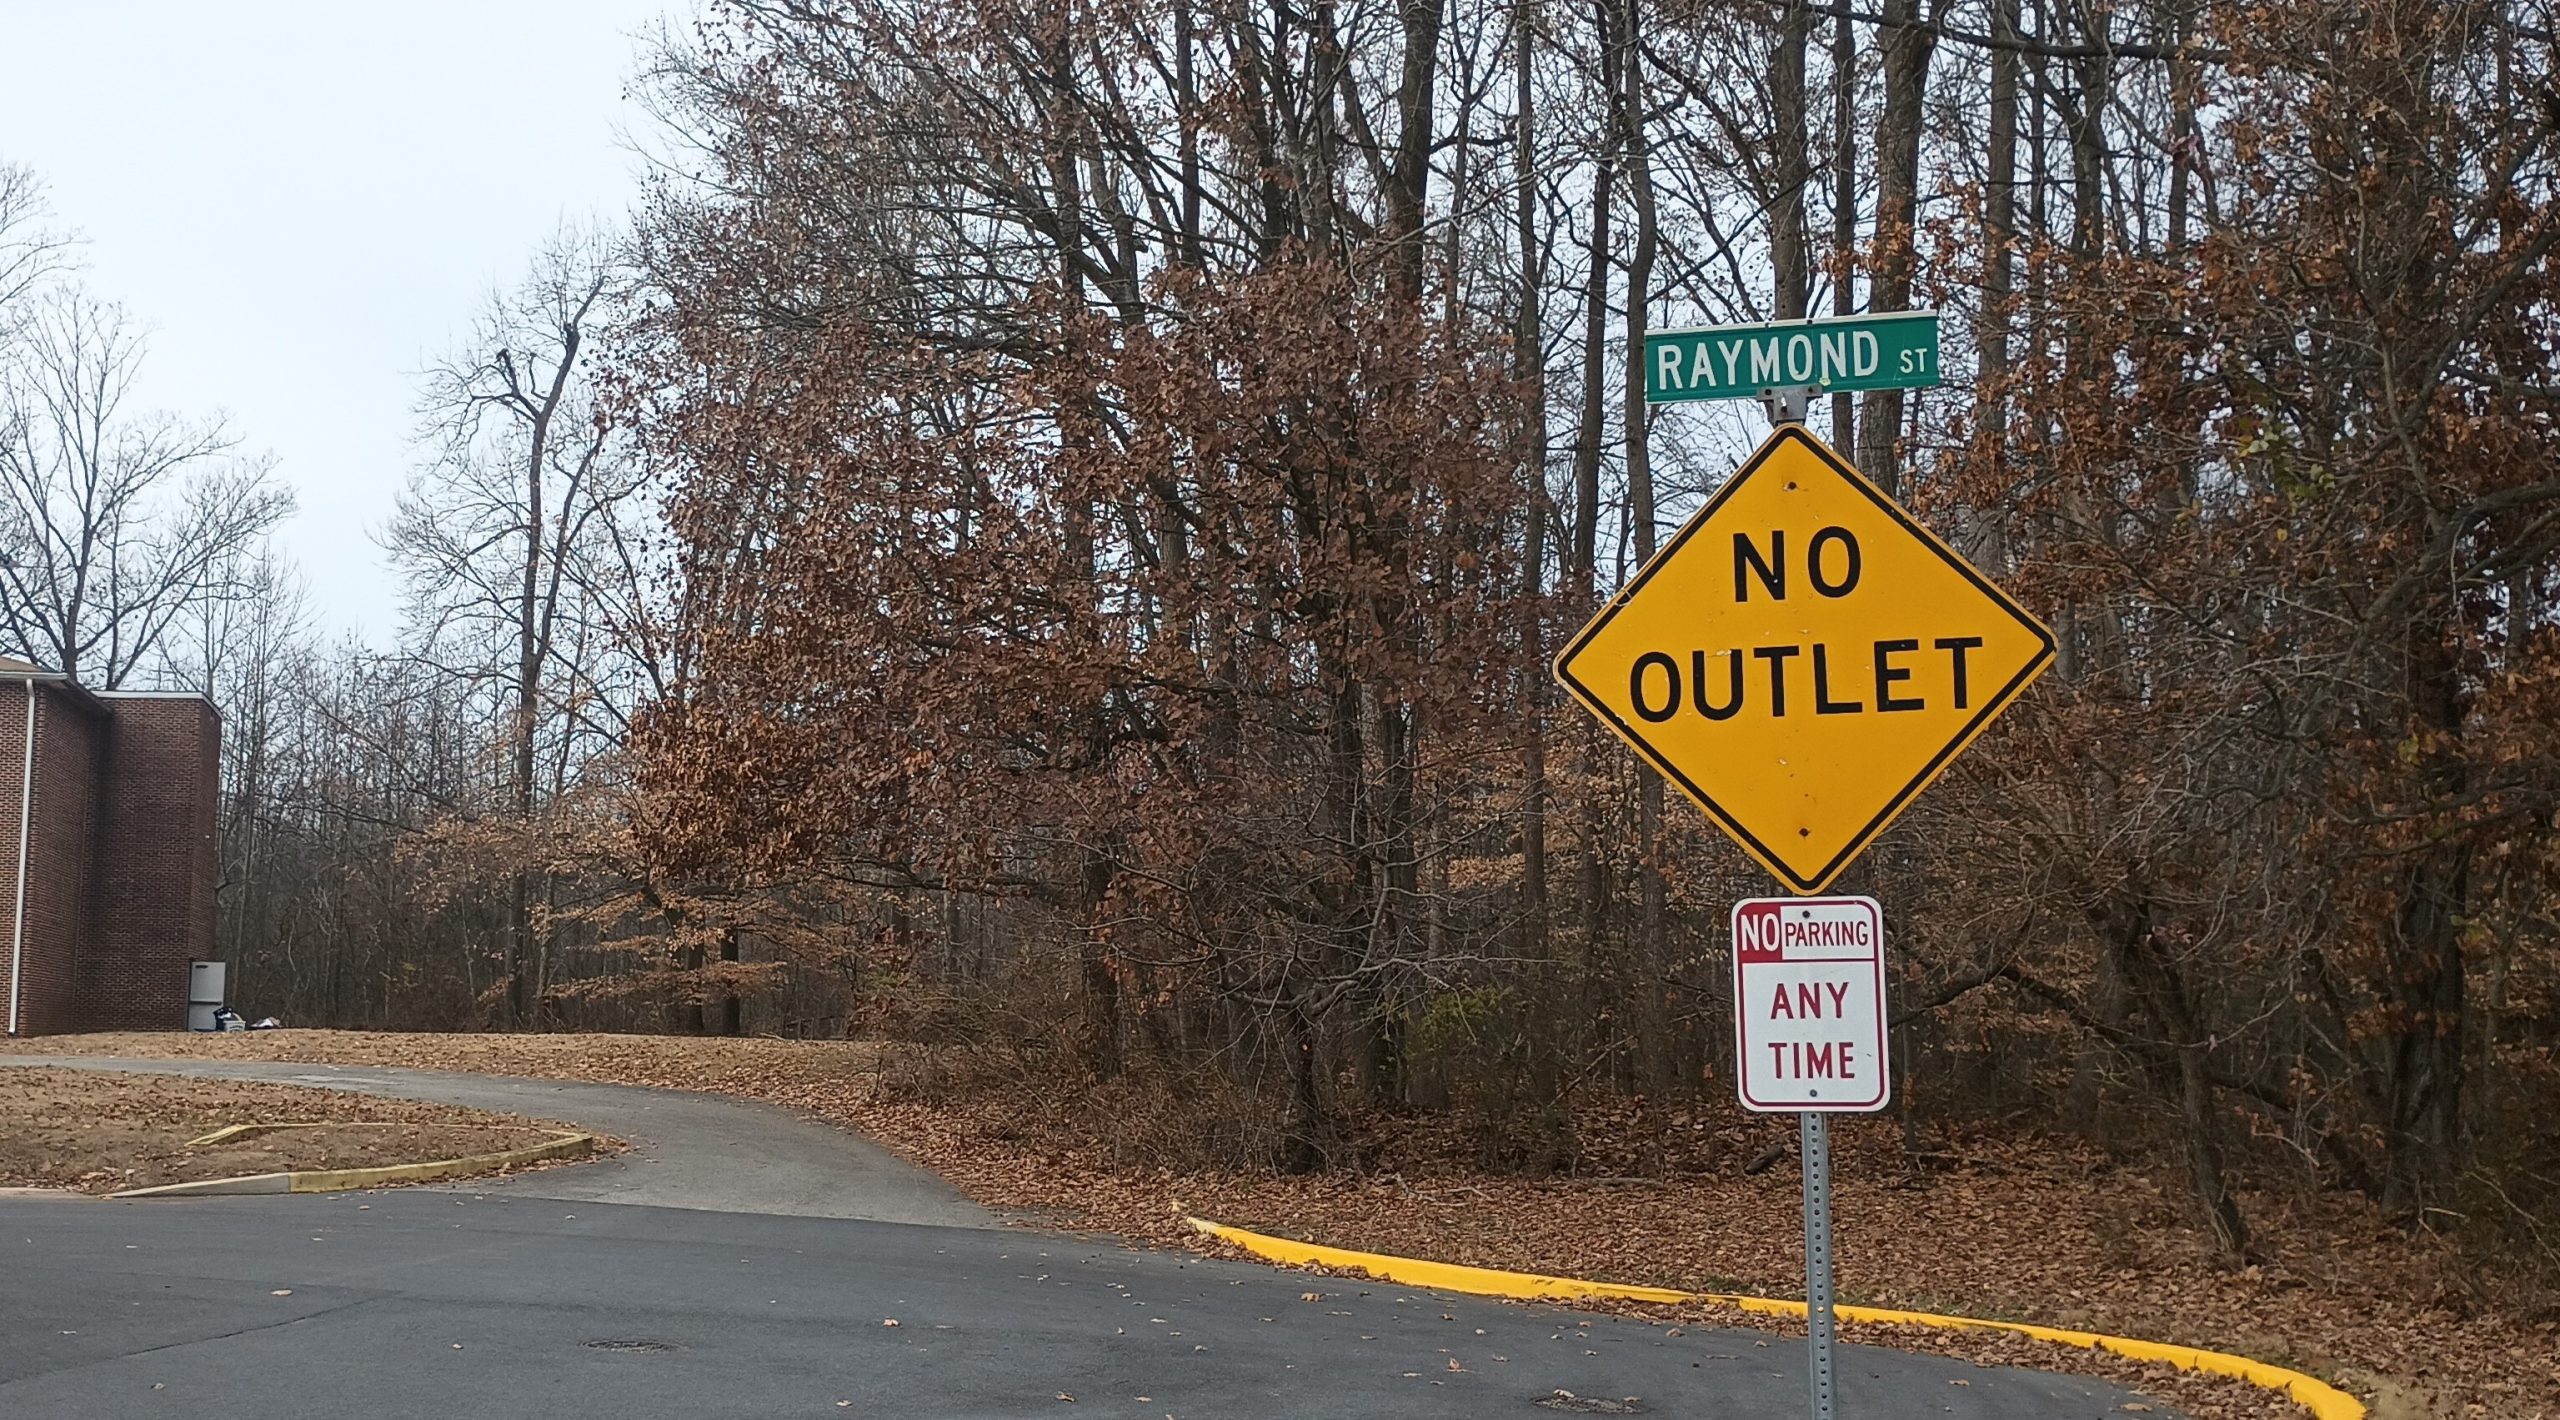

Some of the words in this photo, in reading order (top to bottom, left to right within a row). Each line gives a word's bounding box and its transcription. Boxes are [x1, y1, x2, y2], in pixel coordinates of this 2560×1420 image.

[1657, 330, 1879, 390] RAYMOND
[1900, 348, 1928, 374] ST
[1732, 525, 1862, 603] NO
[1629, 636, 1983, 723] OUTLET
[1740, 912, 1780, 952] NO
[1784, 920, 1869, 947] PARKING
[1770, 981, 1850, 1020] ANY
[1767, 1041, 1856, 1080] TIME
